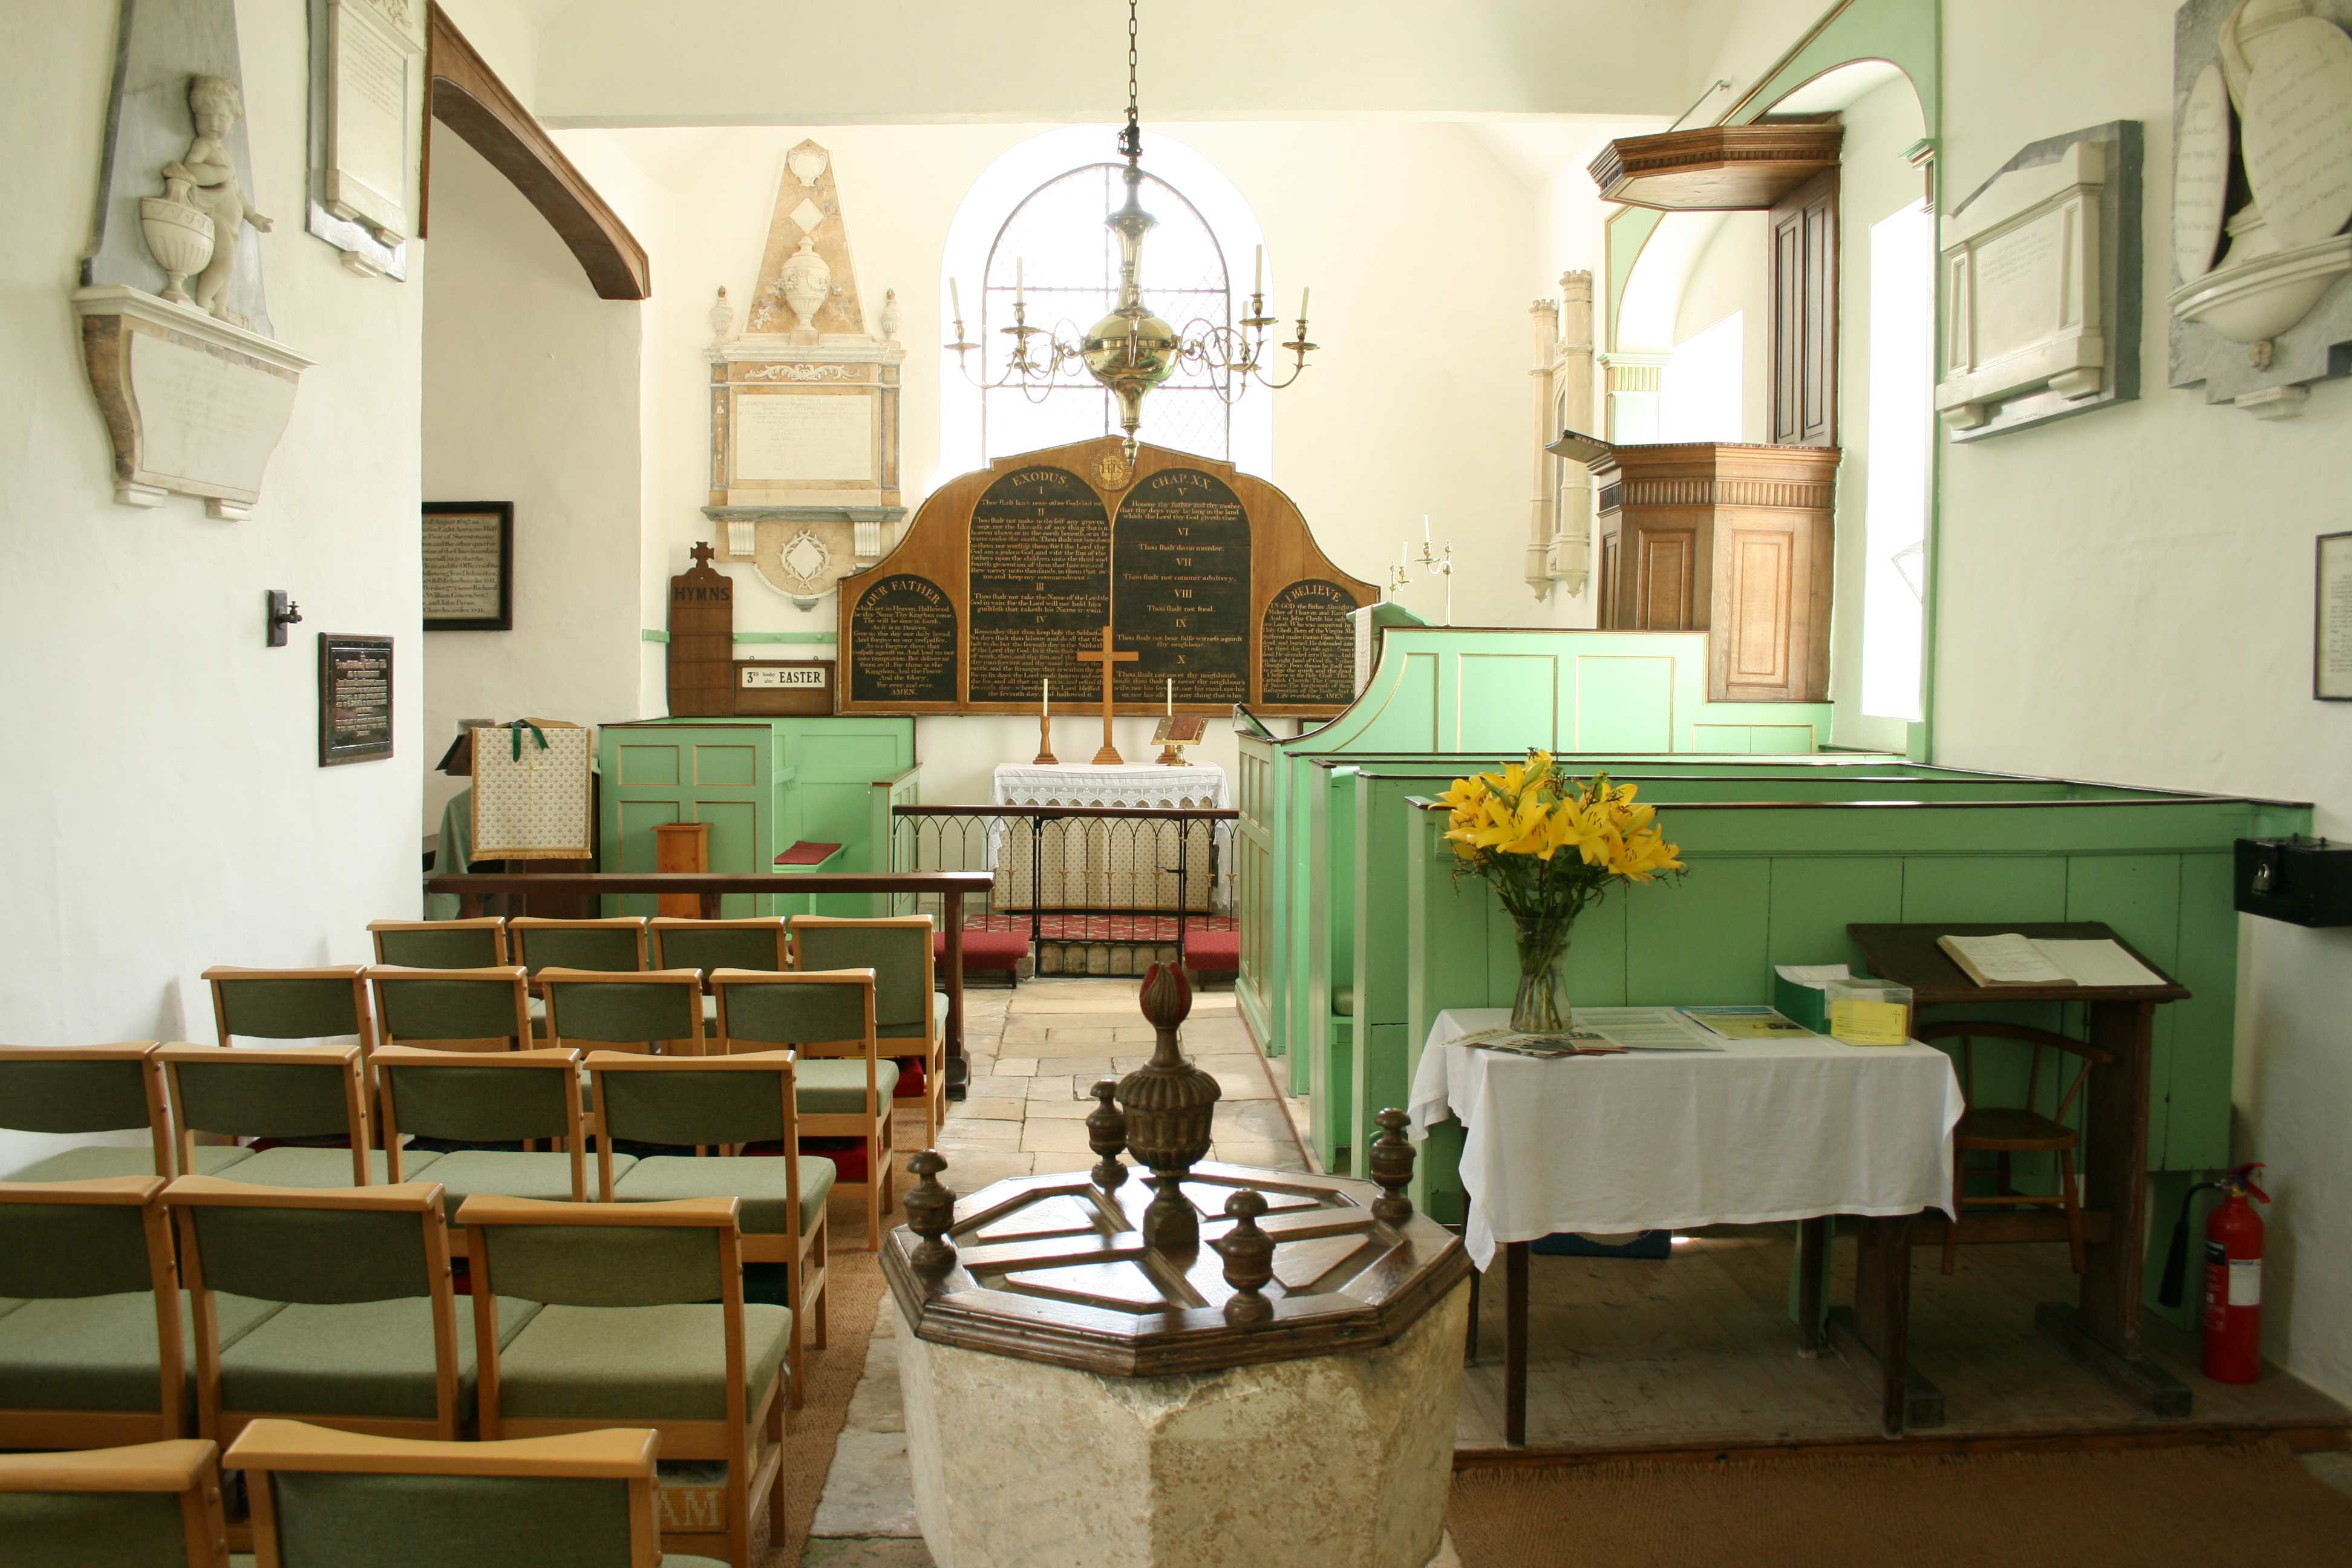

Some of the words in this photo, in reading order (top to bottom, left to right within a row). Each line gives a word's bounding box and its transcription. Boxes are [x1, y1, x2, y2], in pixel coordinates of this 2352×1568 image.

[1152, 474, 1189, 489] CHAP.
[1178, 488, 1188, 496] V
[1178, 528, 1189, 536] VI
[1176, 558, 1192, 567] VII
[673, 586, 730, 601] HYMNS
[1174, 589, 1192, 598] VIII
[1292, 584, 1342, 603] BELIEVE
[1175, 618, 1187, 627] IX
[1177, 655, 1186, 664] X
[779, 671, 822, 683] EASTER
